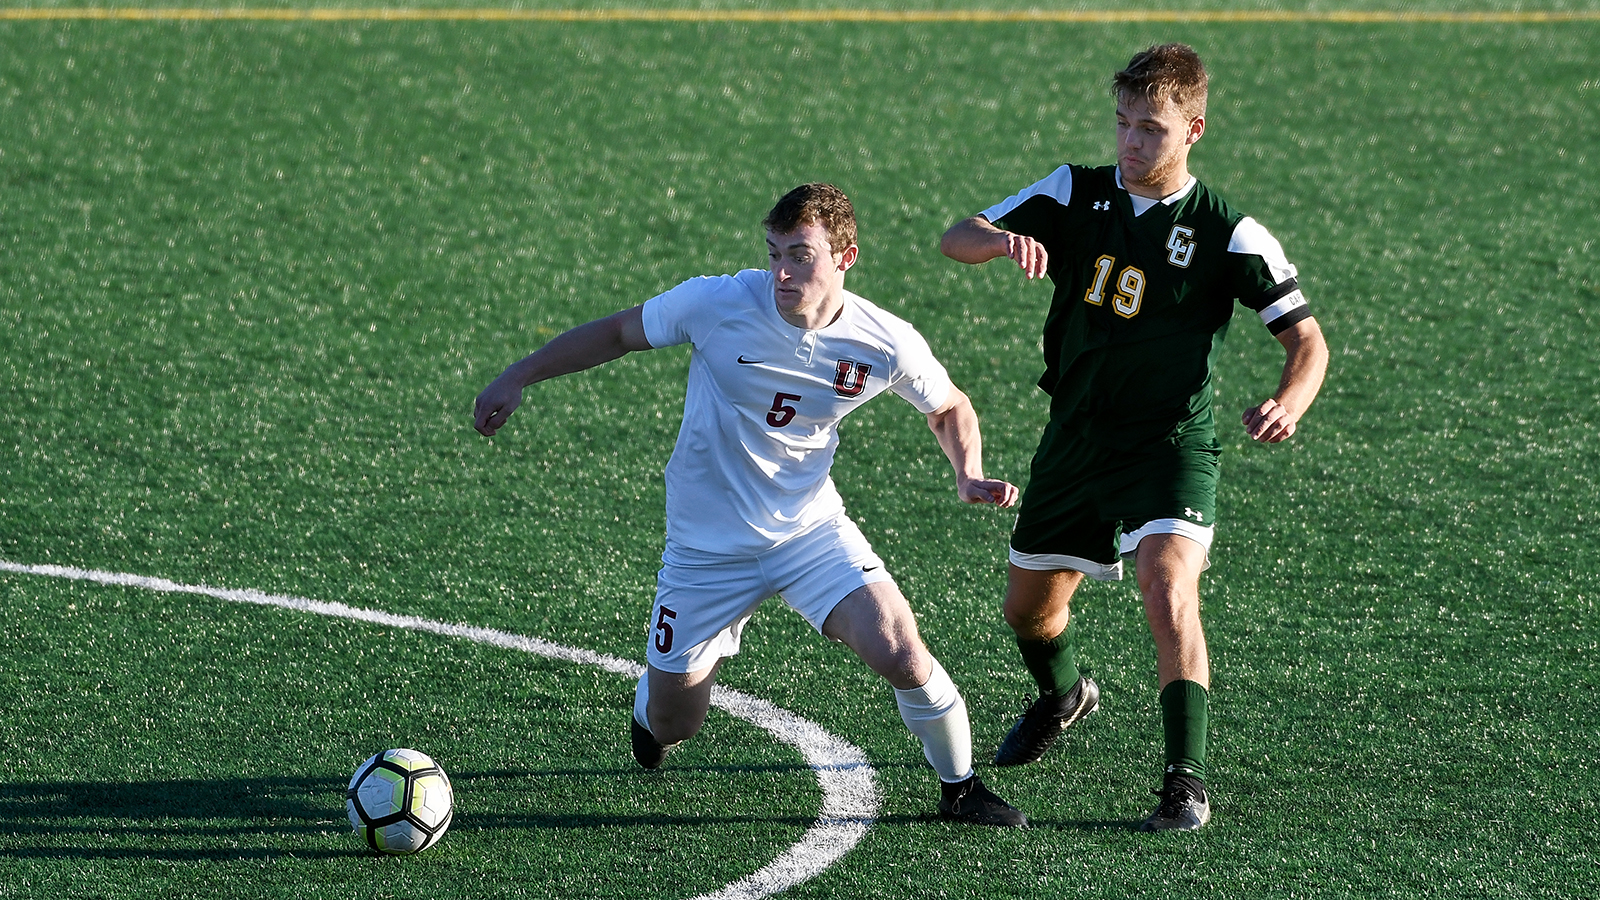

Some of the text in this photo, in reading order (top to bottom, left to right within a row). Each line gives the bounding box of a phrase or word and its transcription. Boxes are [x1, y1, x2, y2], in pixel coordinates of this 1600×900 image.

[1084, 254, 1146, 319] 19
[833, 359, 872, 398] U
[766, 392, 802, 427] 5
[655, 605, 677, 653] 5
